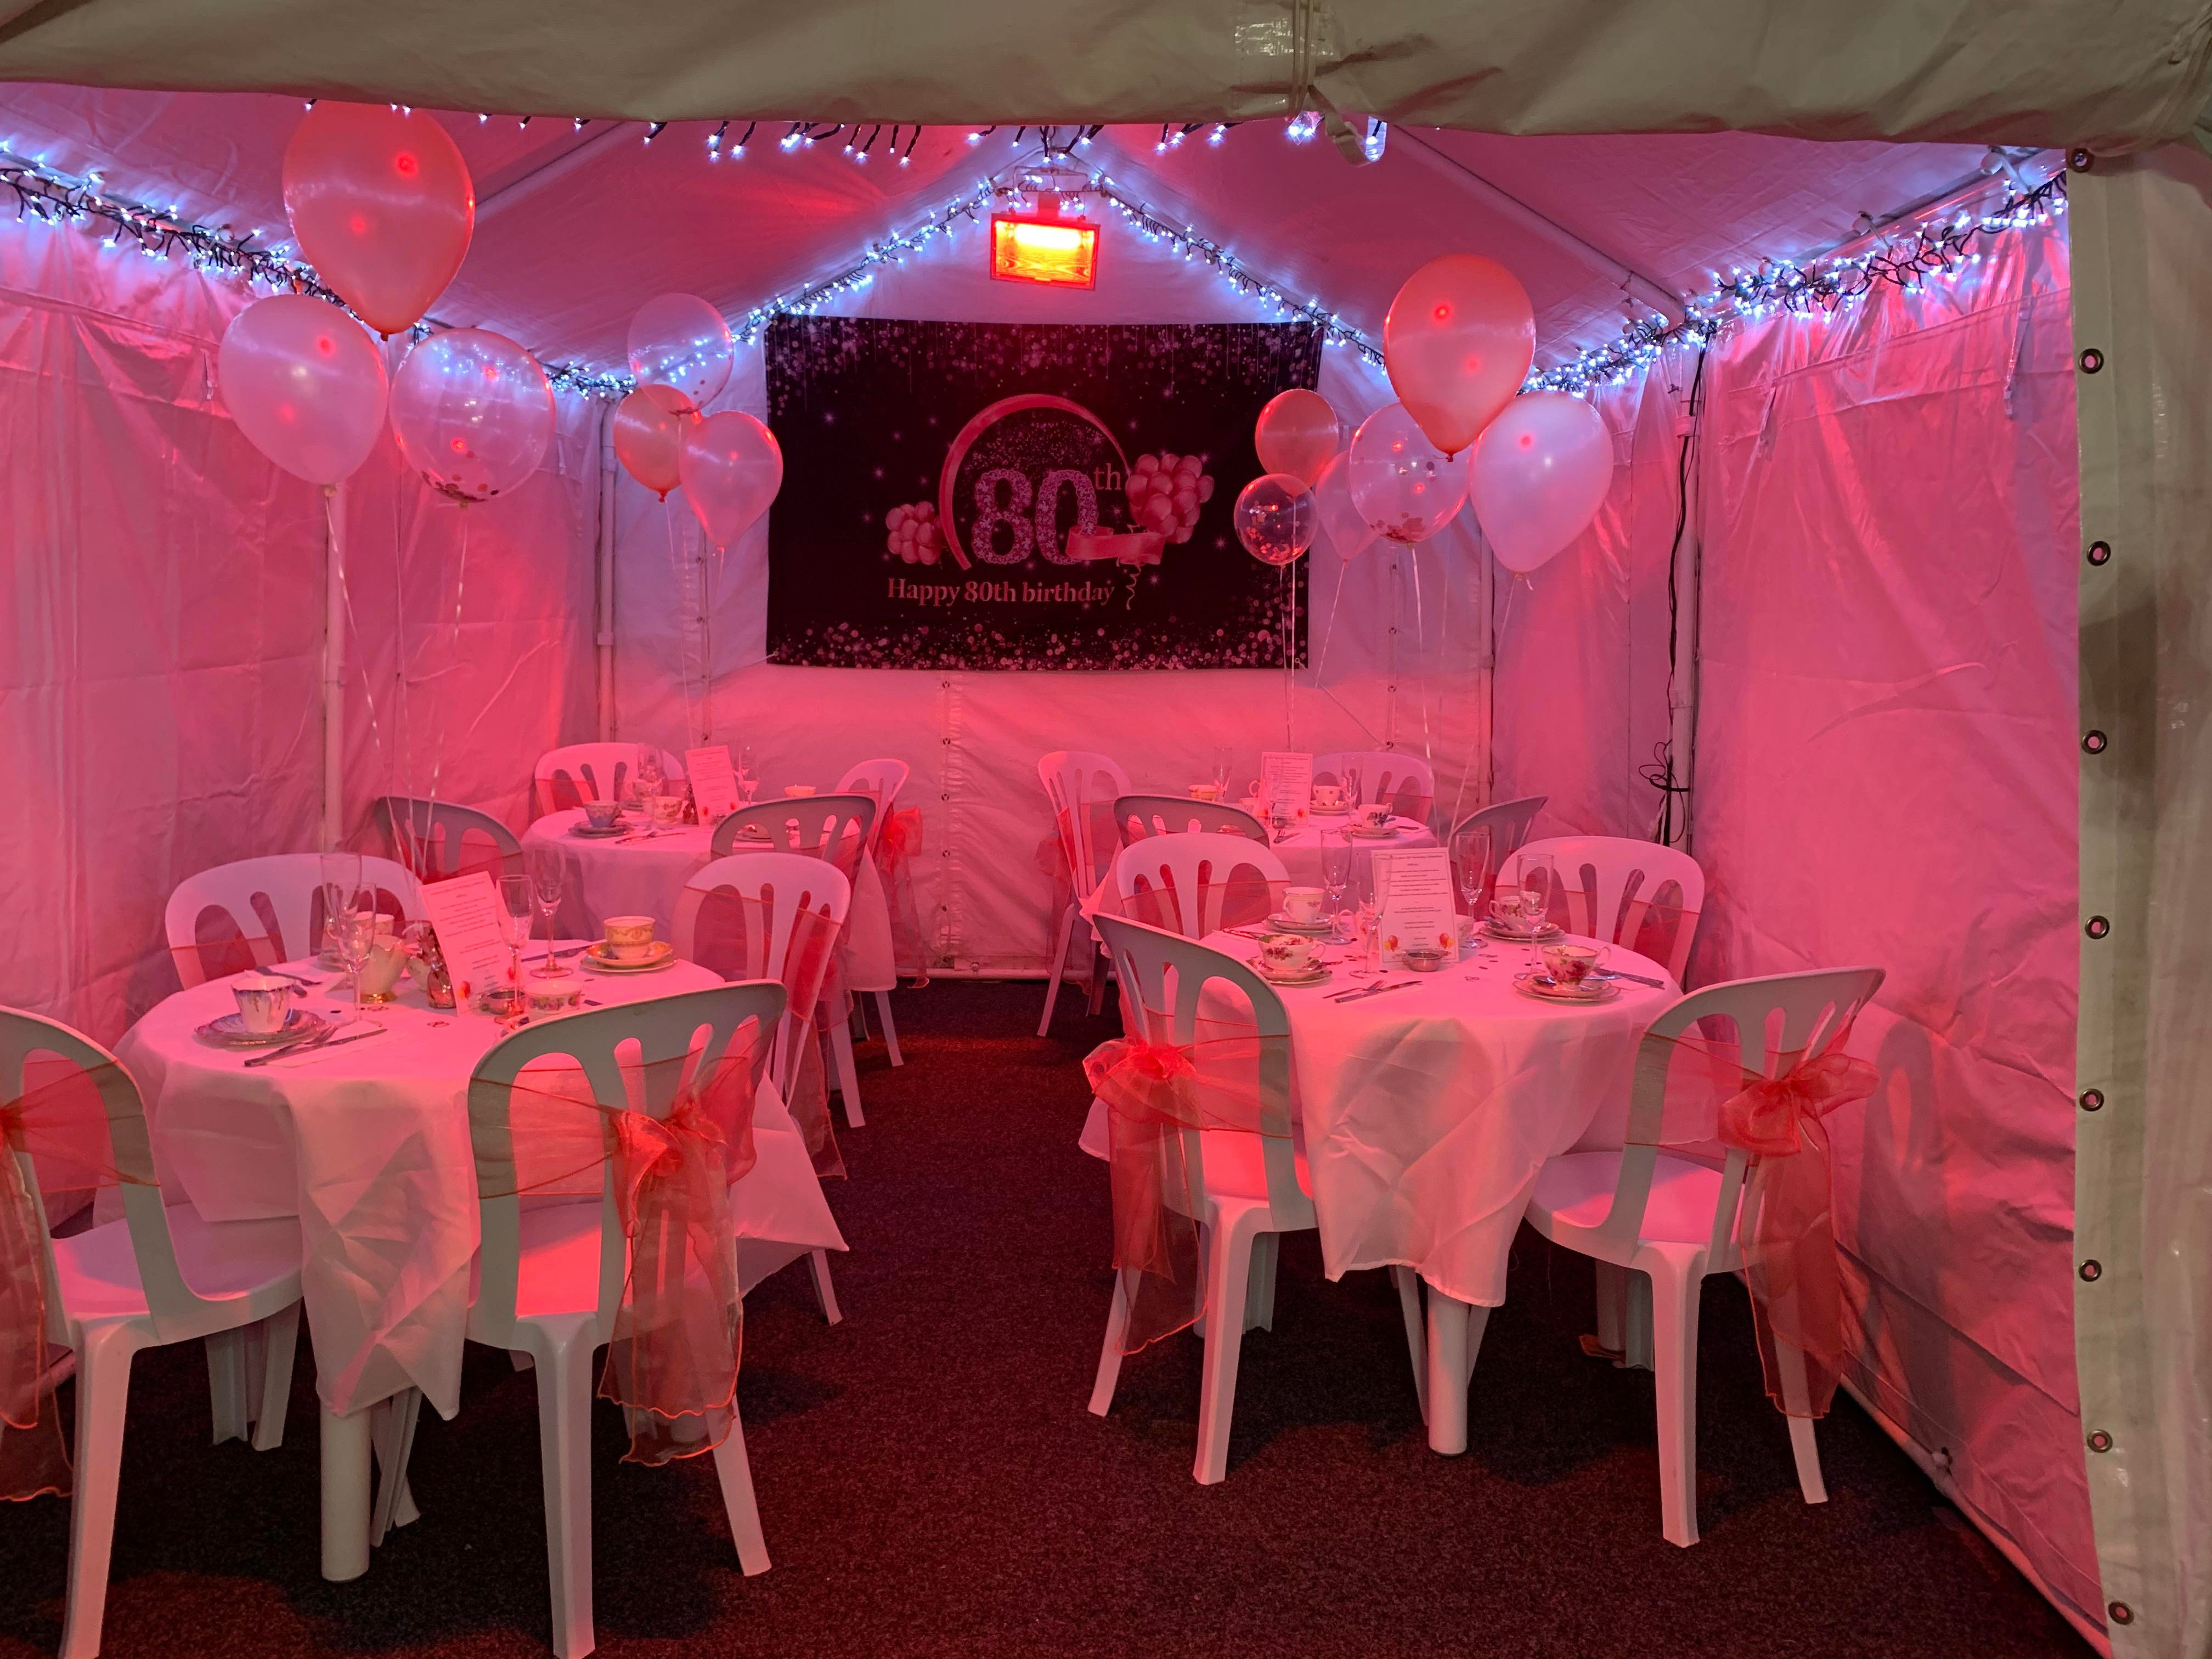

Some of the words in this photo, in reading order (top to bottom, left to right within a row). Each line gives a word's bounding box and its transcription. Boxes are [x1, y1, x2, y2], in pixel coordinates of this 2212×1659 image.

[888, 578, 960, 607] Happy
[964, 581, 1017, 602] 80th
[1023, 581, 1115, 606] birthday
